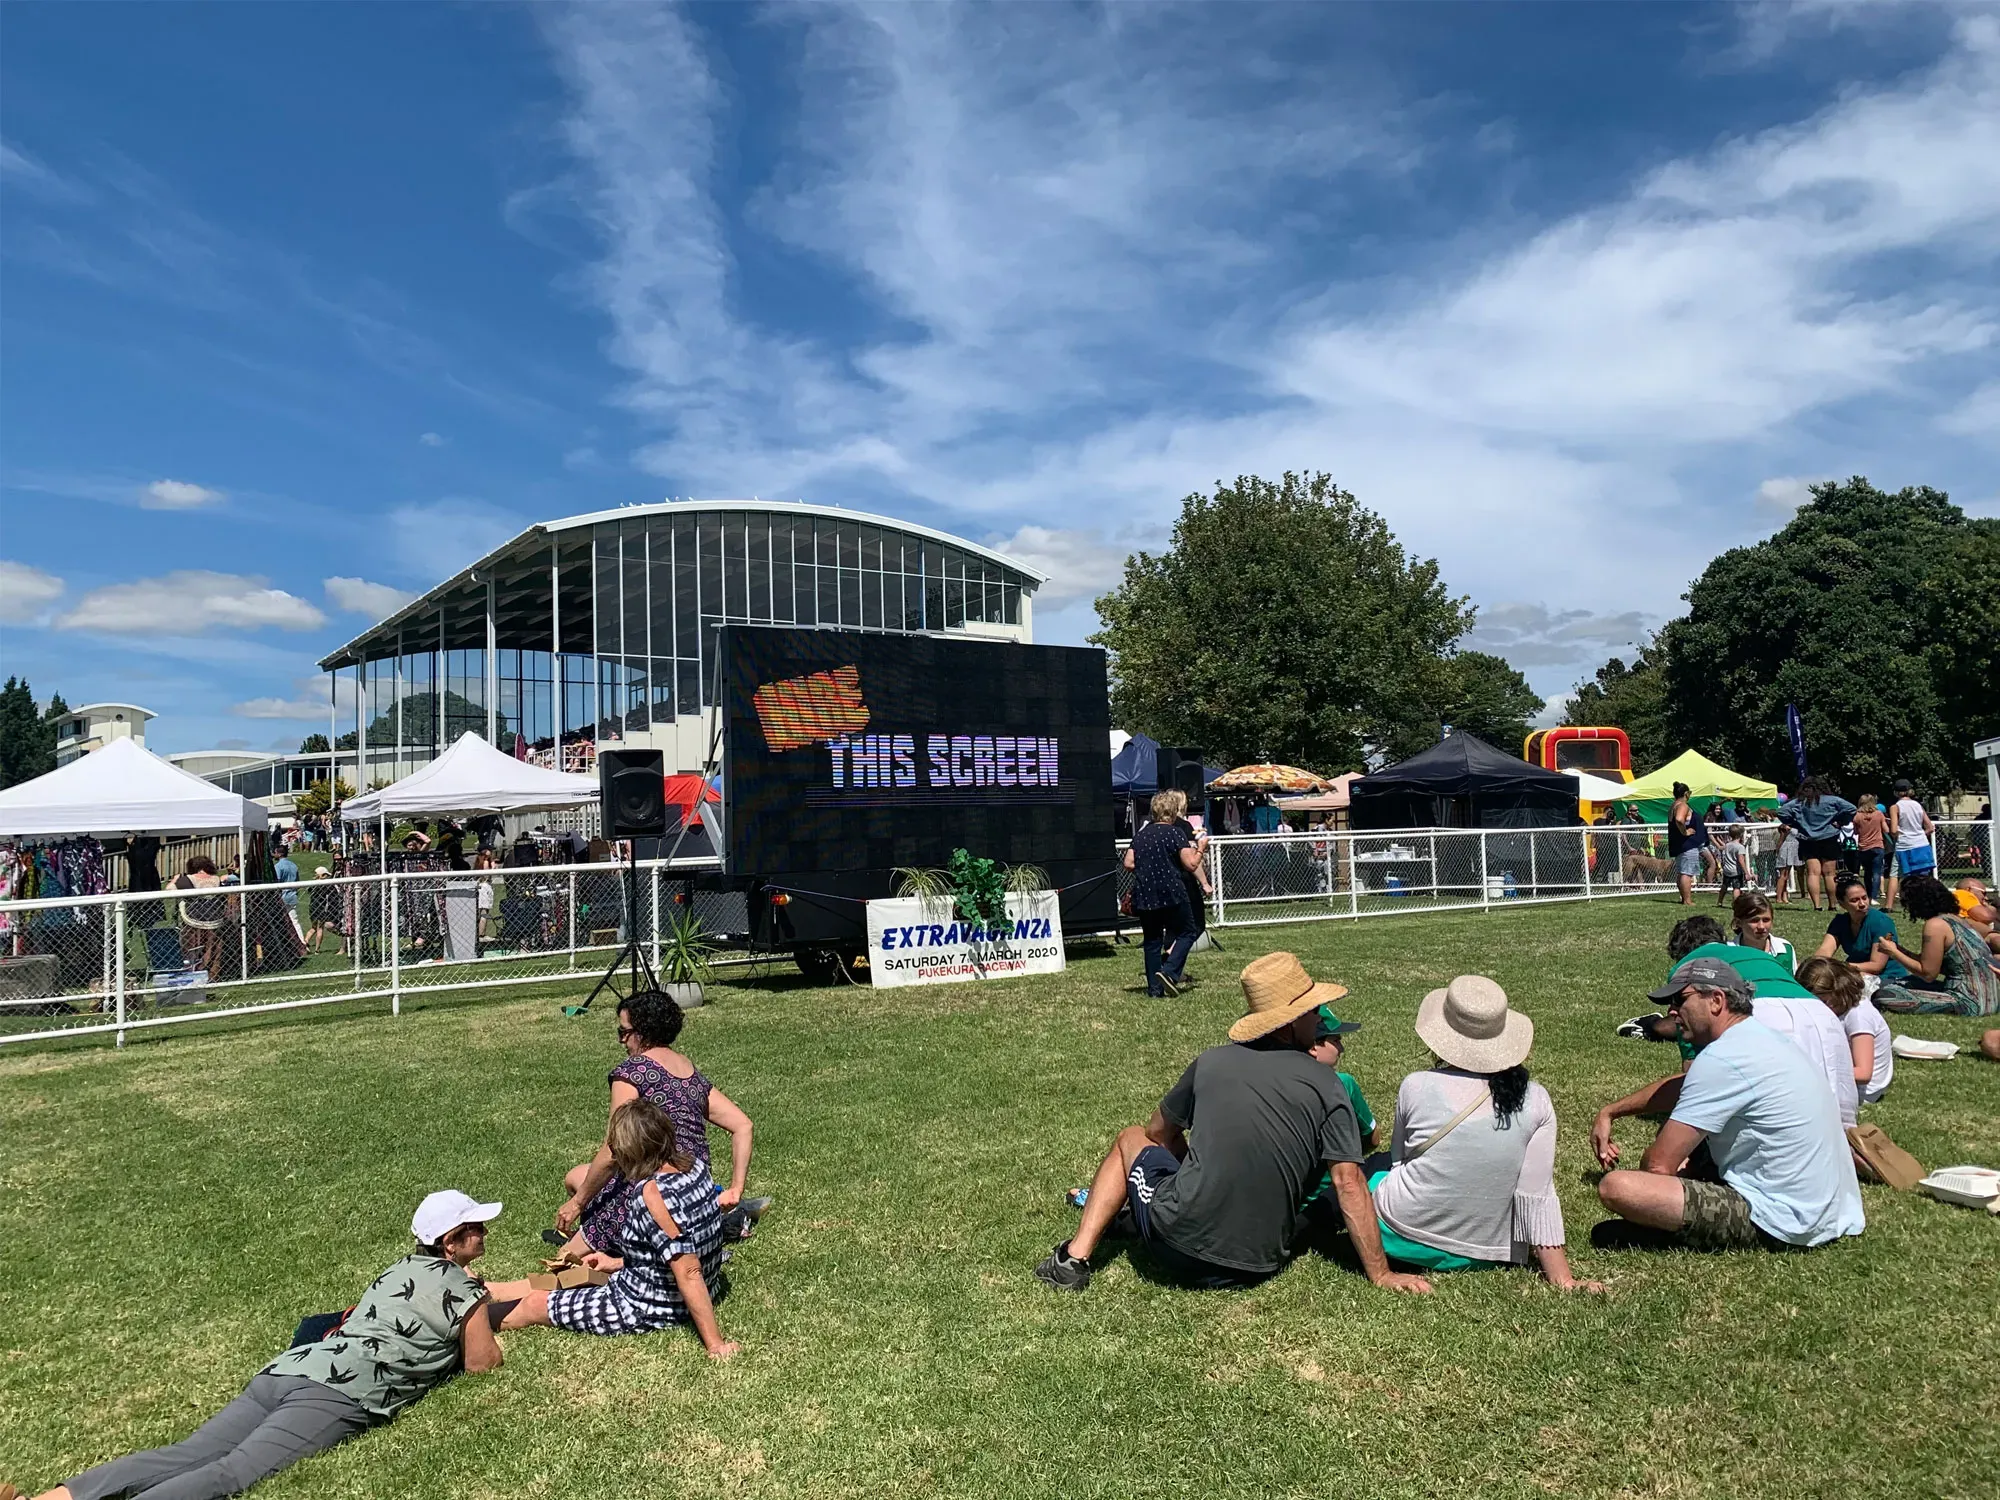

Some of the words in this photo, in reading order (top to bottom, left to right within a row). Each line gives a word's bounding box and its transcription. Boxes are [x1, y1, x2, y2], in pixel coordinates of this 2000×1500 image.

[824, 733, 916, 787] THIS
[927, 733, 1058, 787] SCREEN
[884, 953, 956, 970] SATURDAY
[977, 949, 1022, 962] MARCH
[1027, 946, 1058, 959] 2020
[918, 965, 975, 979] PUKEKURA
[978, 960, 1027, 973] RACEWAY
